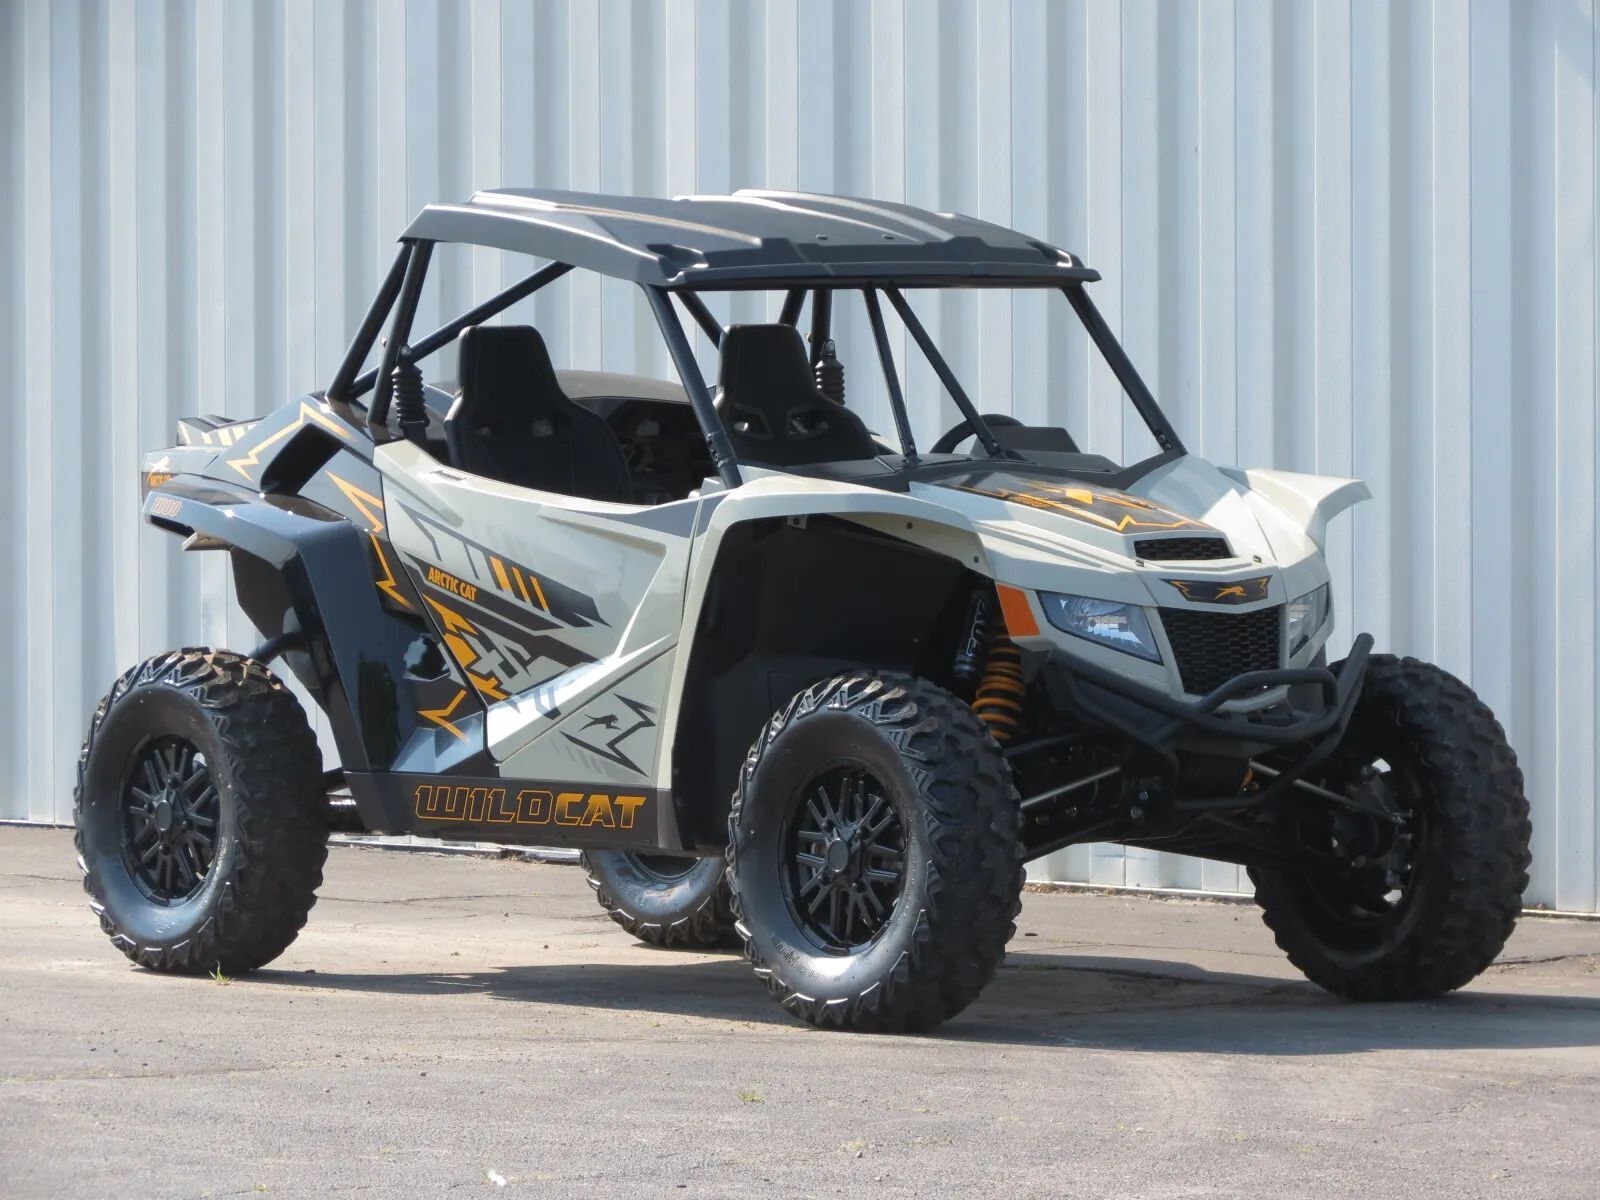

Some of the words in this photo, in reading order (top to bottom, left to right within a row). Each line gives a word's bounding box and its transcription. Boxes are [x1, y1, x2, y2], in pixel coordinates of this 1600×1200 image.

[428, 567, 459, 594] ARCTIC
[459, 582, 477, 601] CAT
[415, 785, 647, 829] WILDCAT
